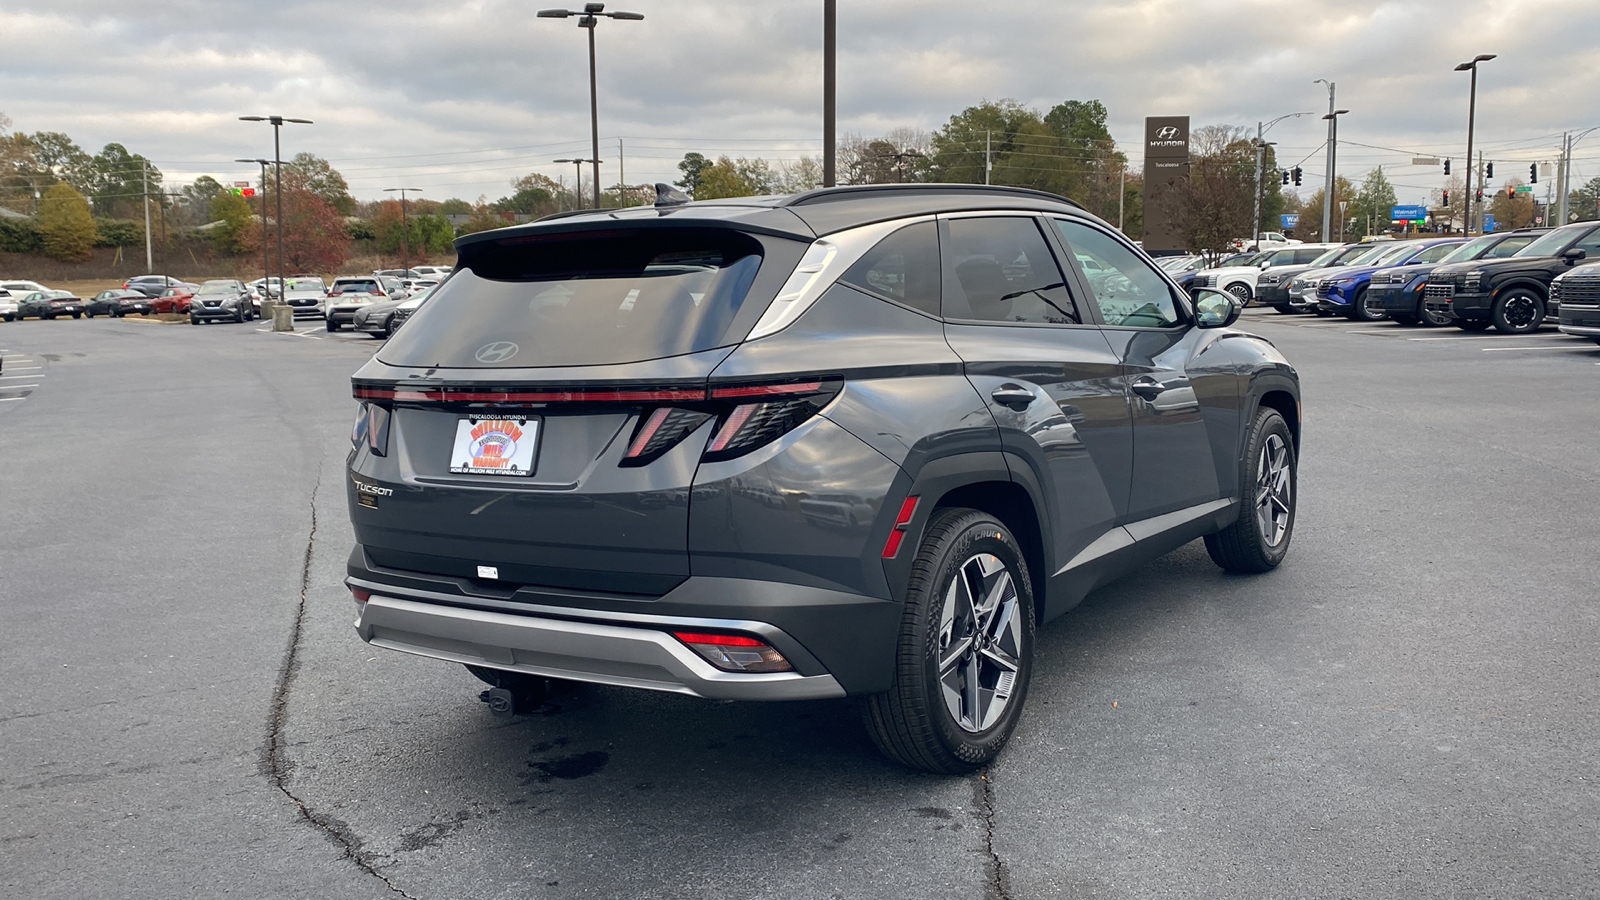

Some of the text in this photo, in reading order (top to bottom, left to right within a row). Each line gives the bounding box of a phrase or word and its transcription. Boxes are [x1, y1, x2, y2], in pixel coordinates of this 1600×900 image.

[470, 419, 523, 443] MILLION
[483, 444, 504, 457] MILE
[472, 456, 510, 468] WARRANTY
[974, 530, 1008, 543] CRUGN
